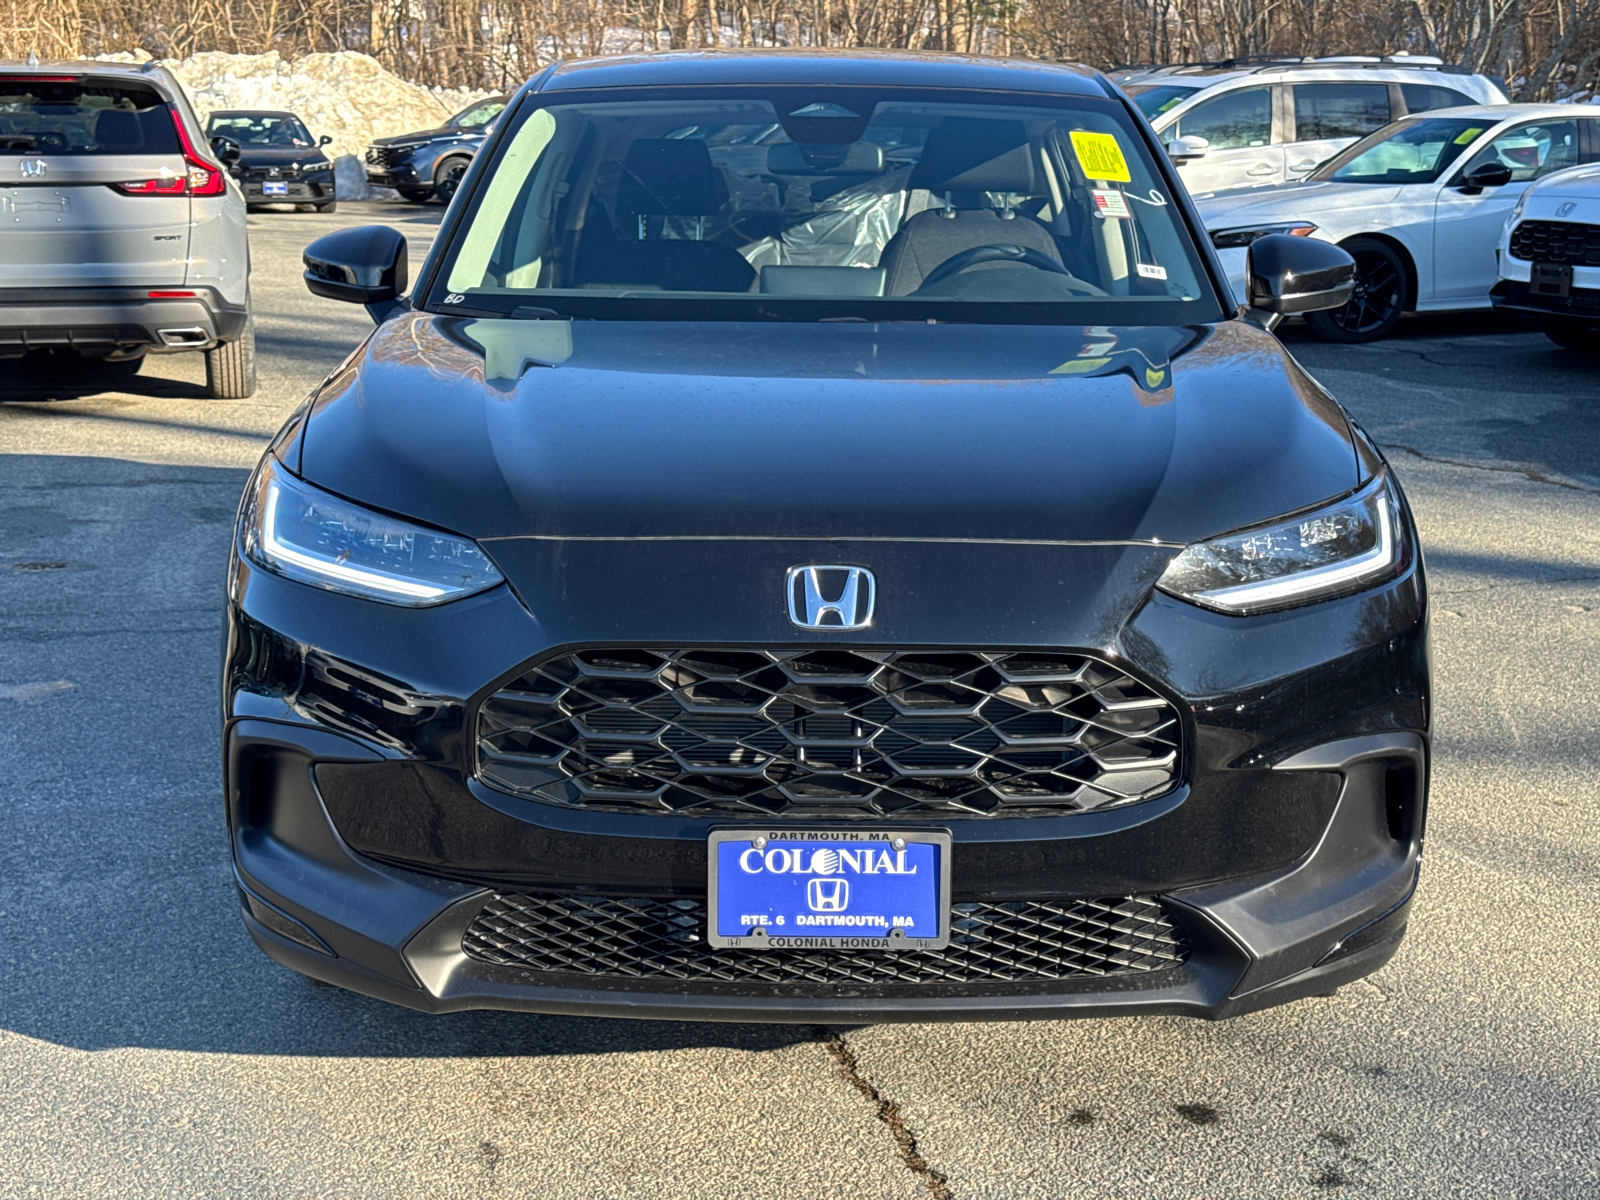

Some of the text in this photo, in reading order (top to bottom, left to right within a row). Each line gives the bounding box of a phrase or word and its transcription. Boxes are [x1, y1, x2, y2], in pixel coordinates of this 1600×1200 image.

[769, 832, 890, 841] DARTMOUTH, MA
[739, 848, 917, 875] COLONIAL
[741, 915, 915, 928] RTE. 6 DARTMOUTH, MA
[768, 937, 890, 948] COLONIAL HONDA
